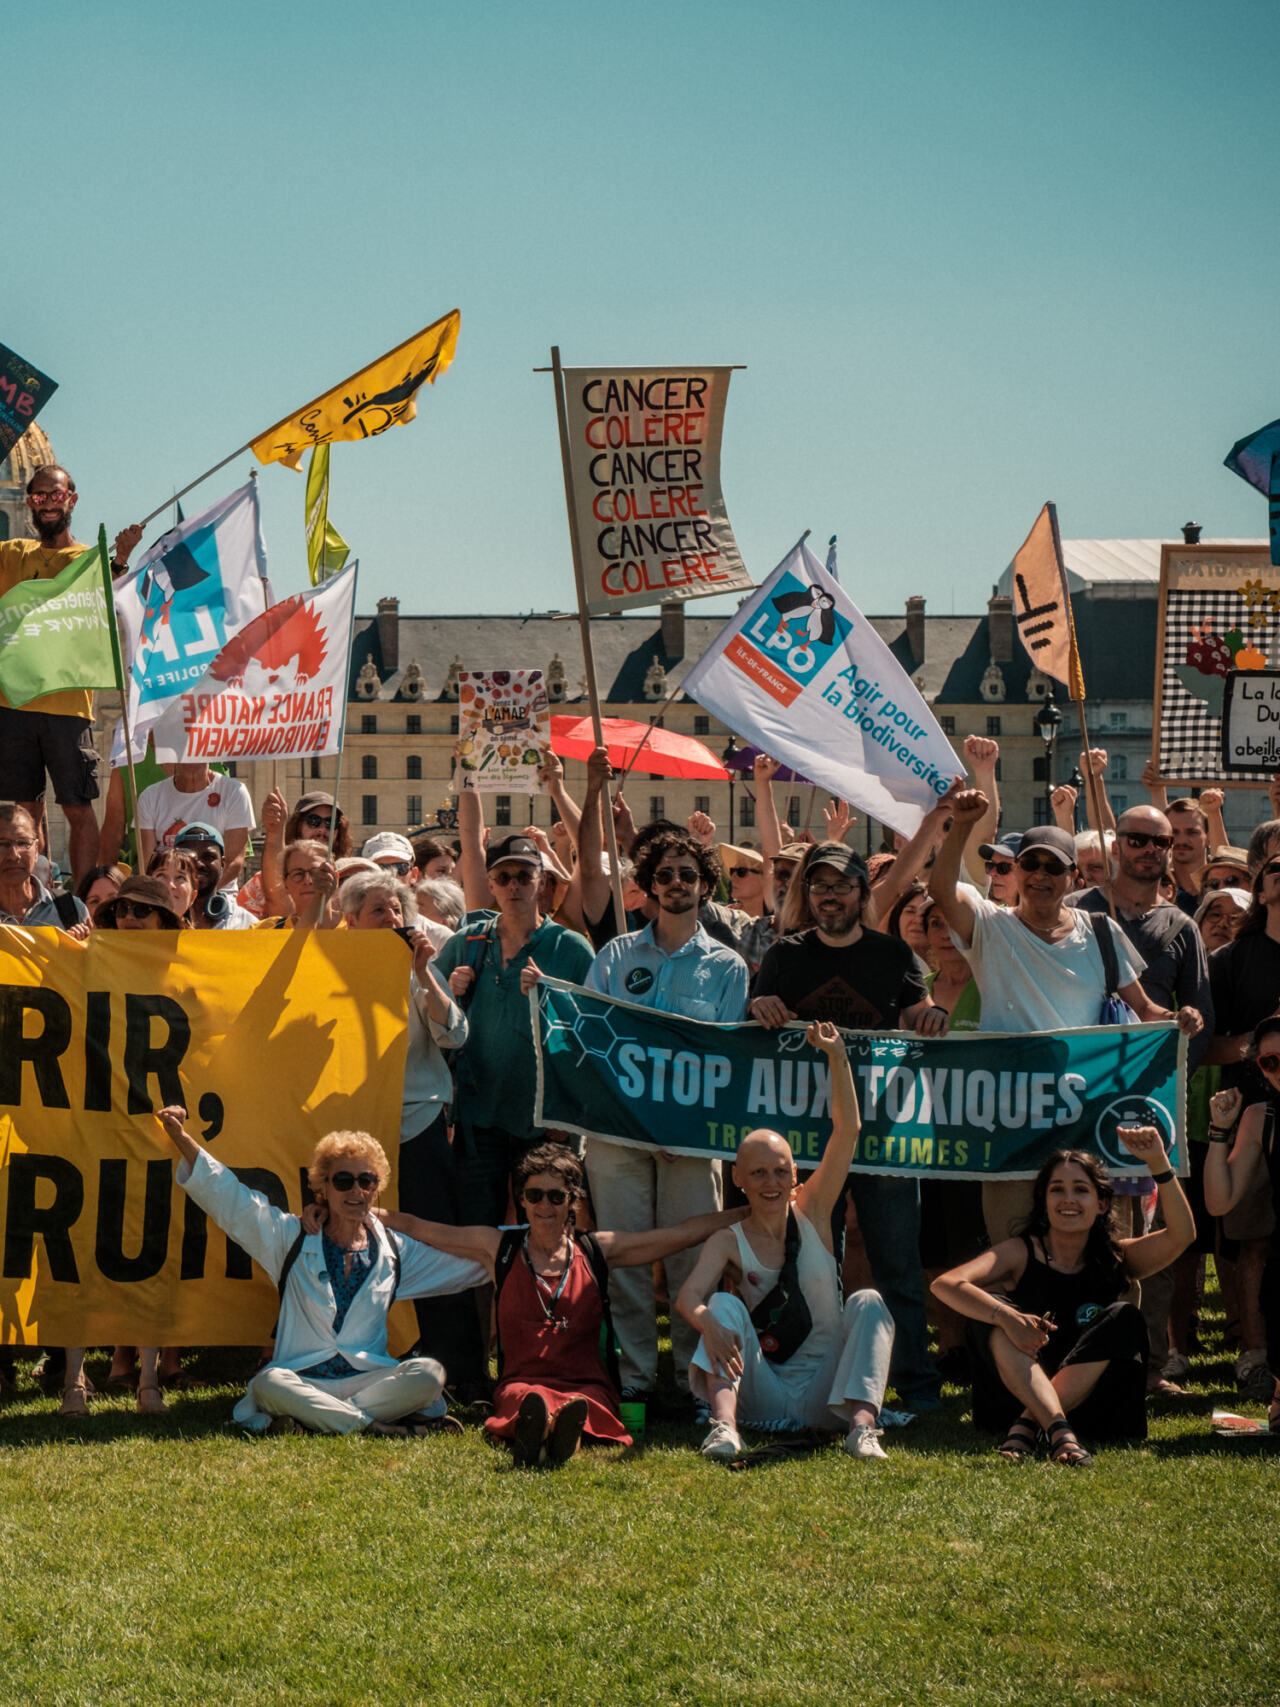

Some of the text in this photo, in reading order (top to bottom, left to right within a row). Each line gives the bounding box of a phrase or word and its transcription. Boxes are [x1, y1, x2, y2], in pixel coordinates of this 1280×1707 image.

[582, 377, 708, 414] CANCER
[585, 412, 705, 450] COLÈRE
[589, 449, 703, 487] CANCER
[592, 484, 708, 523] COLÈRE
[597, 519, 719, 560] CANCER
[601, 552, 729, 596] COLÈRE
[750, 612, 816, 674] LPO
[736, 646, 788, 695] ÎLE-DE-FRANCE
[1242, 681, 1264, 700] La
[837, 663, 928, 741] Agir pour
[821, 681, 952, 796] la biodiversité
[618, 1043, 1087, 1134] STOP AUX TOXIQUES
[789, 1130, 820, 1157] DE
[854, 1134, 970, 1167] ICTIMES
